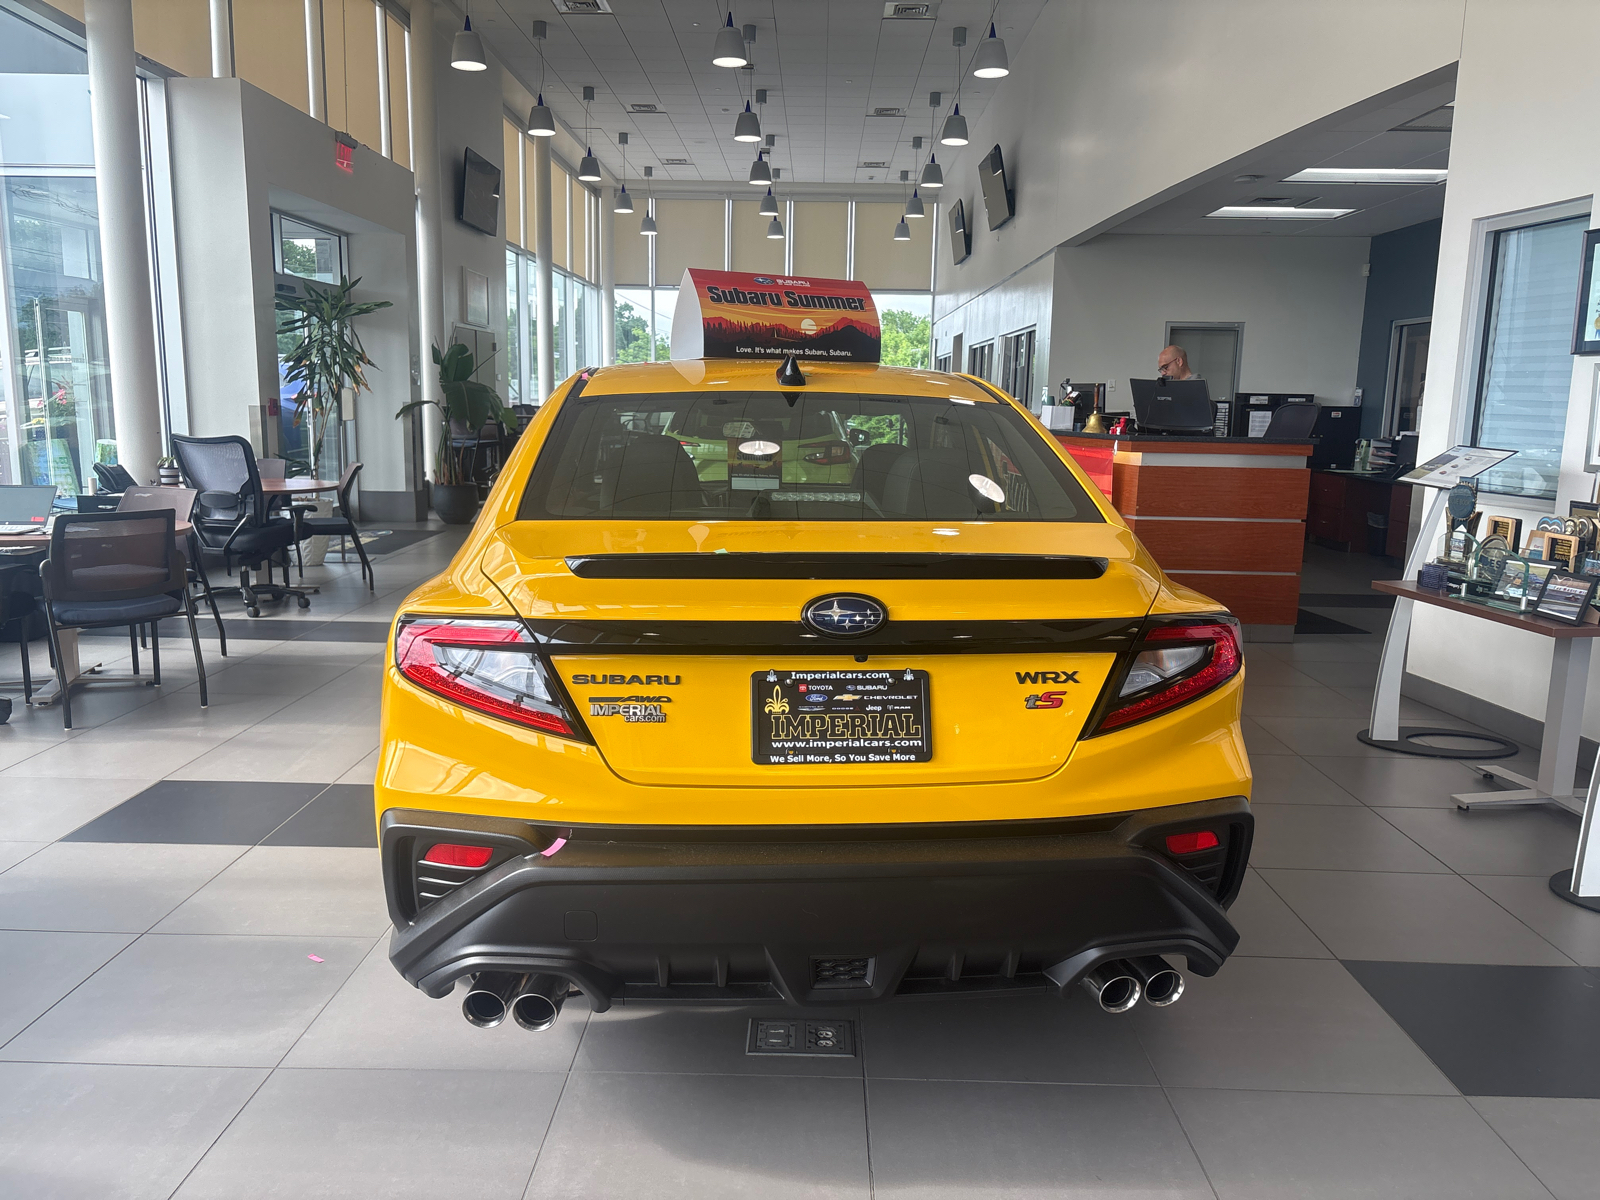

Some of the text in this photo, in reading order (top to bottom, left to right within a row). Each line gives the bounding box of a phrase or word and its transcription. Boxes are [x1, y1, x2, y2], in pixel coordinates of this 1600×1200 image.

[706, 286, 866, 312] Subaru Summer
[755, 346, 764, 354] It's
[805, 348, 828, 357] Subaru,
[829, 349, 852, 357] Subaru.
[572, 674, 681, 685] SUBARU
[791, 671, 890, 681] Imperialcars.com
[1015, 671, 1081, 684] WRX
[620, 695, 672, 703] AWD
[1024, 691, 1067, 710] tS
[590, 704, 666, 716] IMPERIAL
[624, 715, 666, 723] cars.com
[771, 713, 922, 740] IMPERIAL
[771, 739, 922, 749] www.imperialcars.com
[770, 755, 786, 763] We
[787, 755, 804, 763] Sell
[806, 754, 832, 763] More,
[834, 754, 847, 762] So
[848, 754, 866, 762] You
[868, 754, 891, 762] Save
